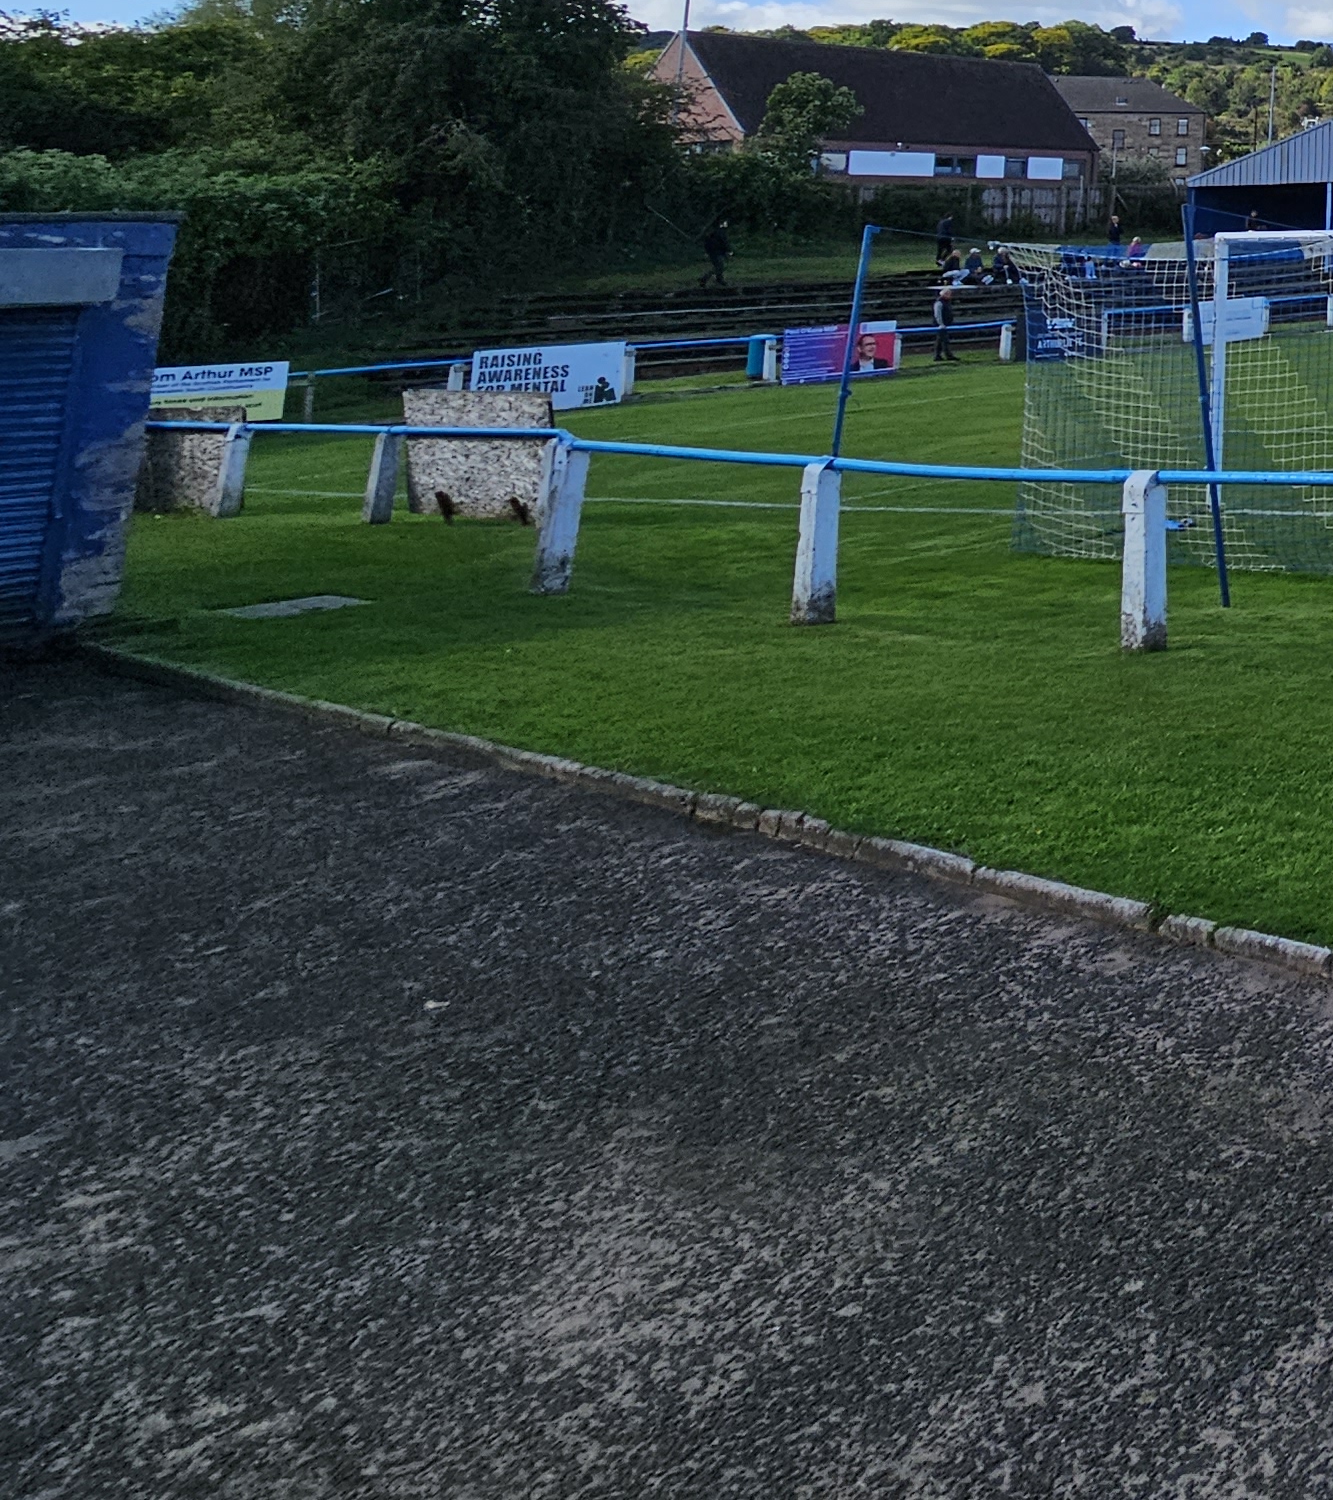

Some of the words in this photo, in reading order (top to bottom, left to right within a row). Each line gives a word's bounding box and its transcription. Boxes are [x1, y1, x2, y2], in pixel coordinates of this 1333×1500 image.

[479, 352, 543, 369] RAISING
[151, 372, 176, 382] om
[181, 369, 234, 380] Arthur
[240, 366, 273, 377] MSP
[476, 364, 570, 386] AWARENESS
[510, 379, 567, 393] MENTAL
